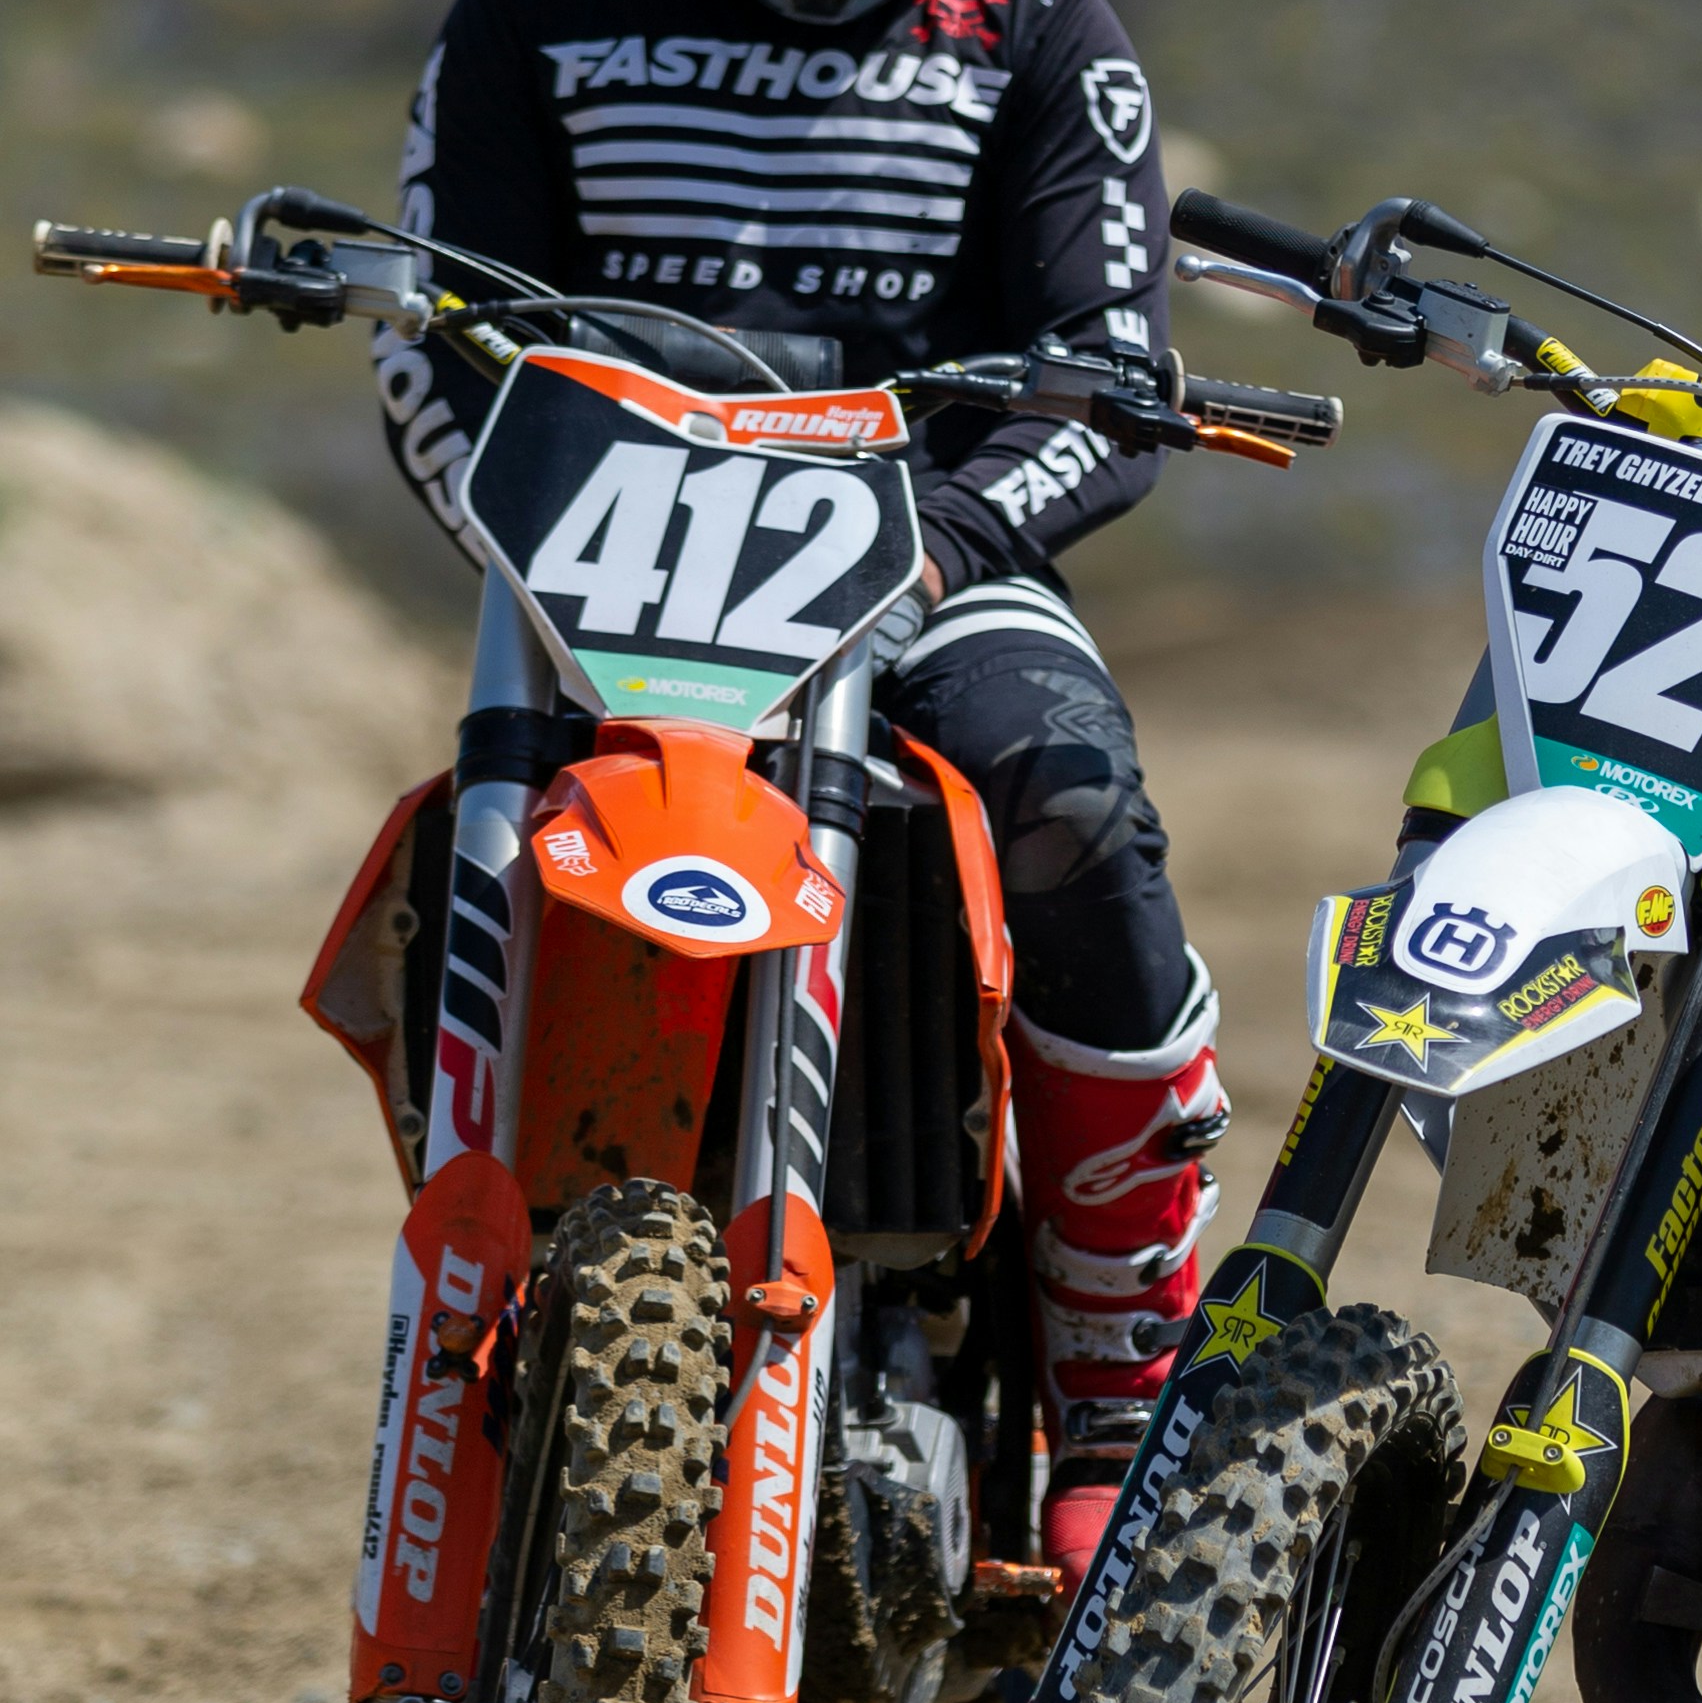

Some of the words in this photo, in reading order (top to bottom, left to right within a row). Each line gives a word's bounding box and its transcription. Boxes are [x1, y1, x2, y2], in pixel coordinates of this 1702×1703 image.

[541, 35, 1014, 123] FASTHOUSE
[603, 250, 763, 292] SPEED
[795, 264, 936, 302] SHOP
[731, 408, 880, 440] ROUND
[1552, 436, 1612, 474] TREY
[1524, 486, 1594, 526] HAPPY
[527, 440, 881, 661] 412
[1510, 511, 1579, 556] HOUR
[647, 676, 750, 707] MOTOREX
[1600, 760, 1698, 812] MOTOREX
[543, 830, 590, 863] FOX
[795, 881, 834, 925] FOX
[1637, 893, 1676, 927] FMF
[1500, 954, 1587, 1023] ROCKSTAR
[1522, 995, 1564, 1029] ENERGY
[1561, 977, 1600, 1010] DRINK
